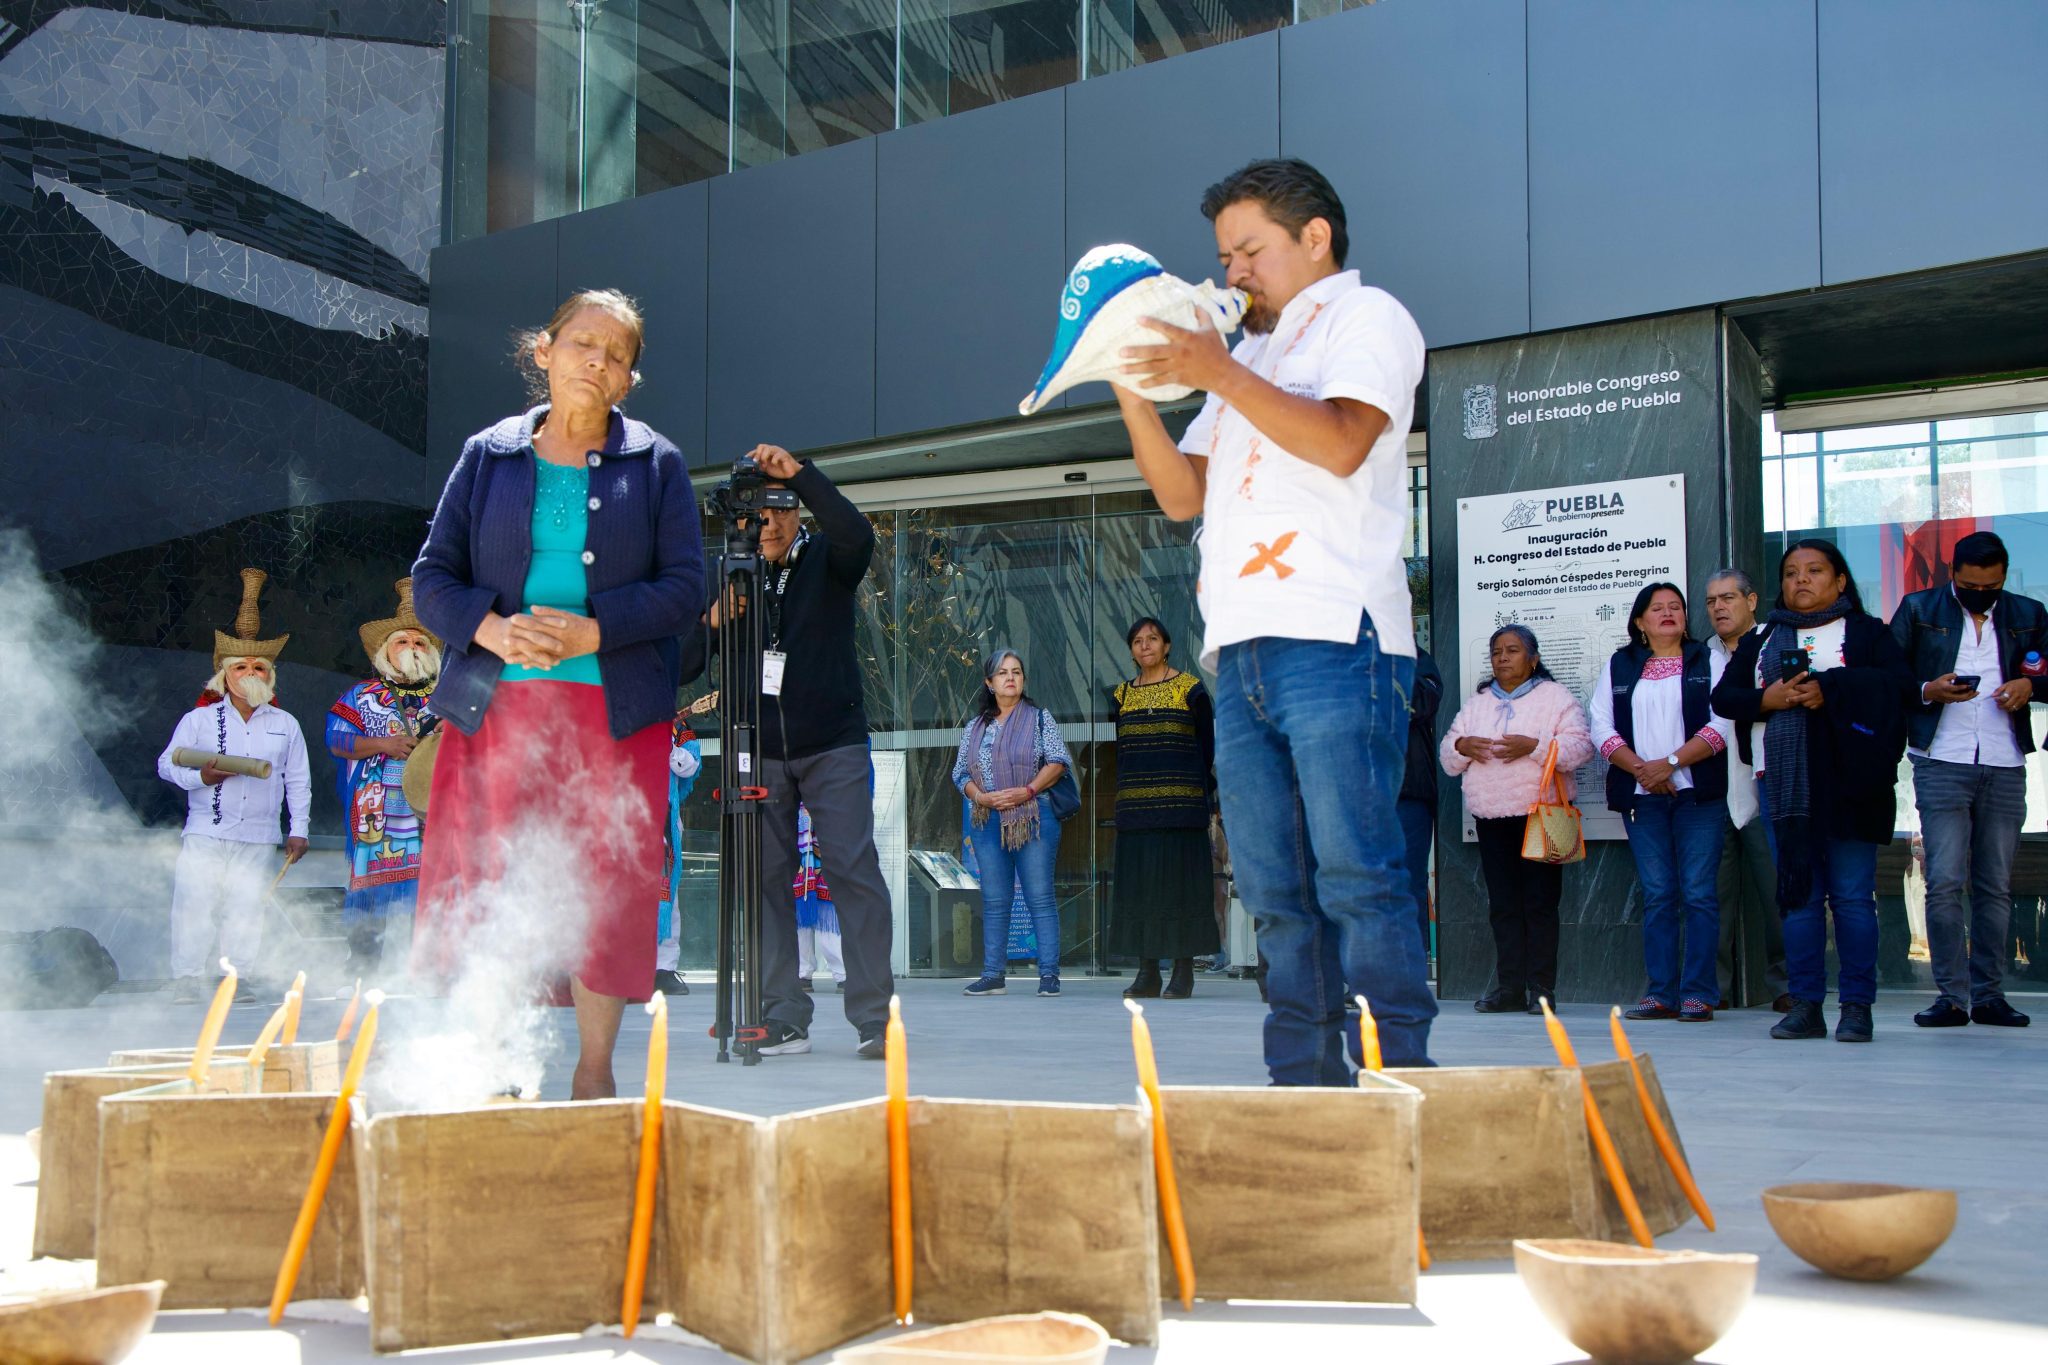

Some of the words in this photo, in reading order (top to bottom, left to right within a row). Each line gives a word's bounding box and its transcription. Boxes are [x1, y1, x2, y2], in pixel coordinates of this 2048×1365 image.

[1507, 381, 1592, 404] Honorable
[1596, 370, 1680, 392] Congreso
[1506, 410, 1532, 426] del
[1536, 403, 1592, 422] Estado
[1596, 400, 1617, 414] de
[1622, 390, 1681, 410] Puebla
[1546, 492, 1624, 514] PUEBLA
[1590, 508, 1624, 519] presente
[1528, 528, 1608, 545] Inauguración
[1474, 555, 1485, 564] H.
[1487, 550, 1542, 564] Congreso
[1544, 548, 1562, 558] del
[1565, 543, 1605, 556] Estado
[1607, 542, 1622, 552] de
[1624, 538, 1666, 550] Puebla
[776, 568, 791, 594] ESTADO
[1477, 580, 1510, 591] Sergio
[1512, 574, 1558, 587] Salomón
[1560, 570, 1613, 584] Céspedes
[1616, 565, 1669, 578] Peregrina
[1502, 588, 1552, 598] Gobernador
[1569, 584, 1598, 592] Estado
[1613, 580, 1643, 588] Puebla
